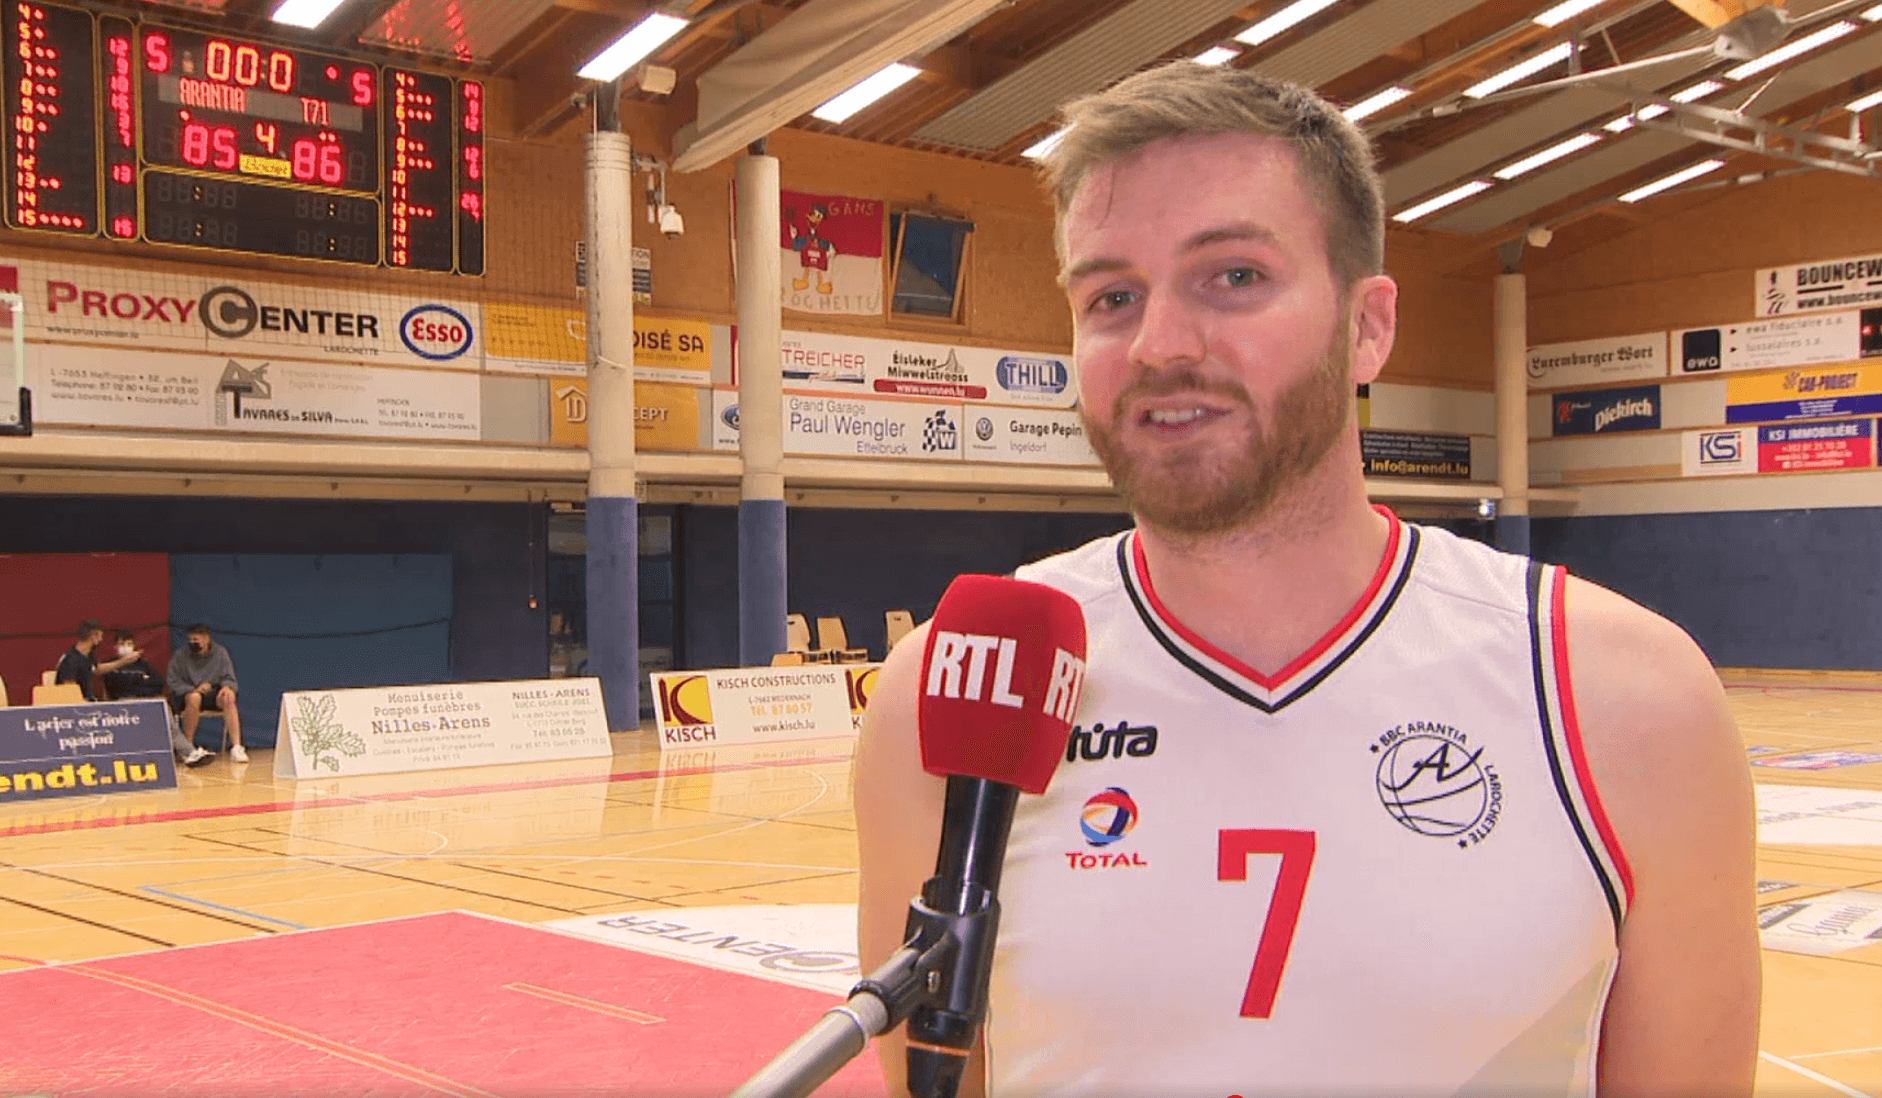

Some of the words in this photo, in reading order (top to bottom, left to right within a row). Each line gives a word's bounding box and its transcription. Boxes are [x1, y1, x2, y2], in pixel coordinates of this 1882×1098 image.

[180, 77, 246, 114] ARANTIA
[301, 97, 330, 126] T71
[255, 122, 276, 154] 4
[293, 140, 342, 183] 86
[678, 334, 705, 353] SA
[1006, 362, 1060, 387] THILL
[301, 411, 333, 423] SILVA
[789, 397, 824, 412] Grand
[826, 400, 867, 417] Garage
[1594, 397, 1655, 432] Diekirch
[789, 412, 829, 434] Paul
[834, 415, 907, 441] Wengler
[1009, 419, 1051, 437] Garage
[1051, 421, 1083, 439] Pepin
[716, 677, 749, 689] KISCH
[751, 673, 836, 688] CONSTRUCTIONS
[926, 630, 1024, 709] RTL
[387, 688, 464, 704] Menuiserie
[373, 704, 420, 718] Pompes
[422, 701, 482, 715] funèbres
[664, 725, 717, 744] KISCH
[1379, 725, 1406, 747] BBC
[1407, 721, 1468, 745] ARANTIA
[1467, 764, 1503, 844] LAROCHETTE
[1065, 851, 1149, 870] TOTAL
[1217, 828, 1317, 1019] 7
